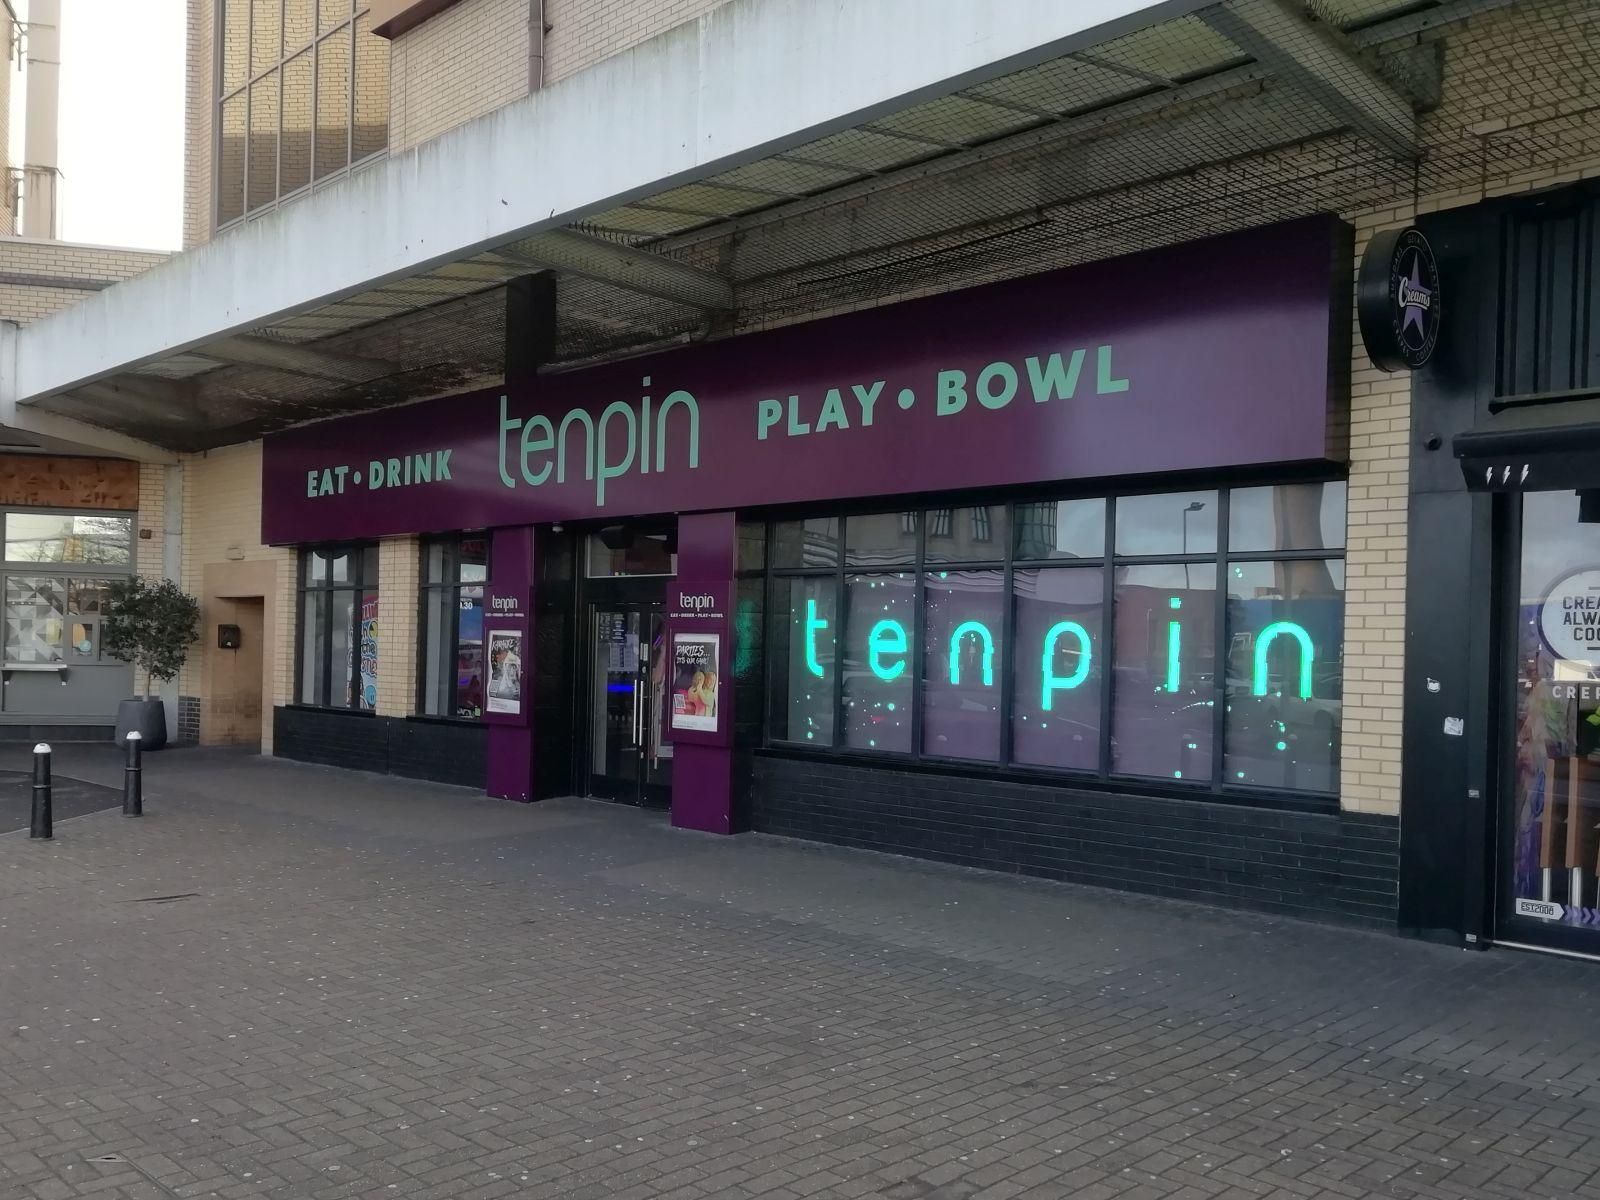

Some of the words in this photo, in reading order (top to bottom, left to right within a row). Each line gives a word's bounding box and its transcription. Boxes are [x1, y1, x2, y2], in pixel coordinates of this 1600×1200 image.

[1398, 277, 1430, 308] Creams
[757, 380, 886, 440] PLAY
[936, 345, 1130, 416] BOWL
[499, 375, 699, 506] tenpin
[307, 465, 350, 498] EAT
[369, 449, 452, 490] DRINK
[492, 595, 517, 611] tenpin
[680, 592, 714, 611] tenpin
[1562, 611, 1600, 626] ALW
[805, 597, 1315, 711] tenpin
